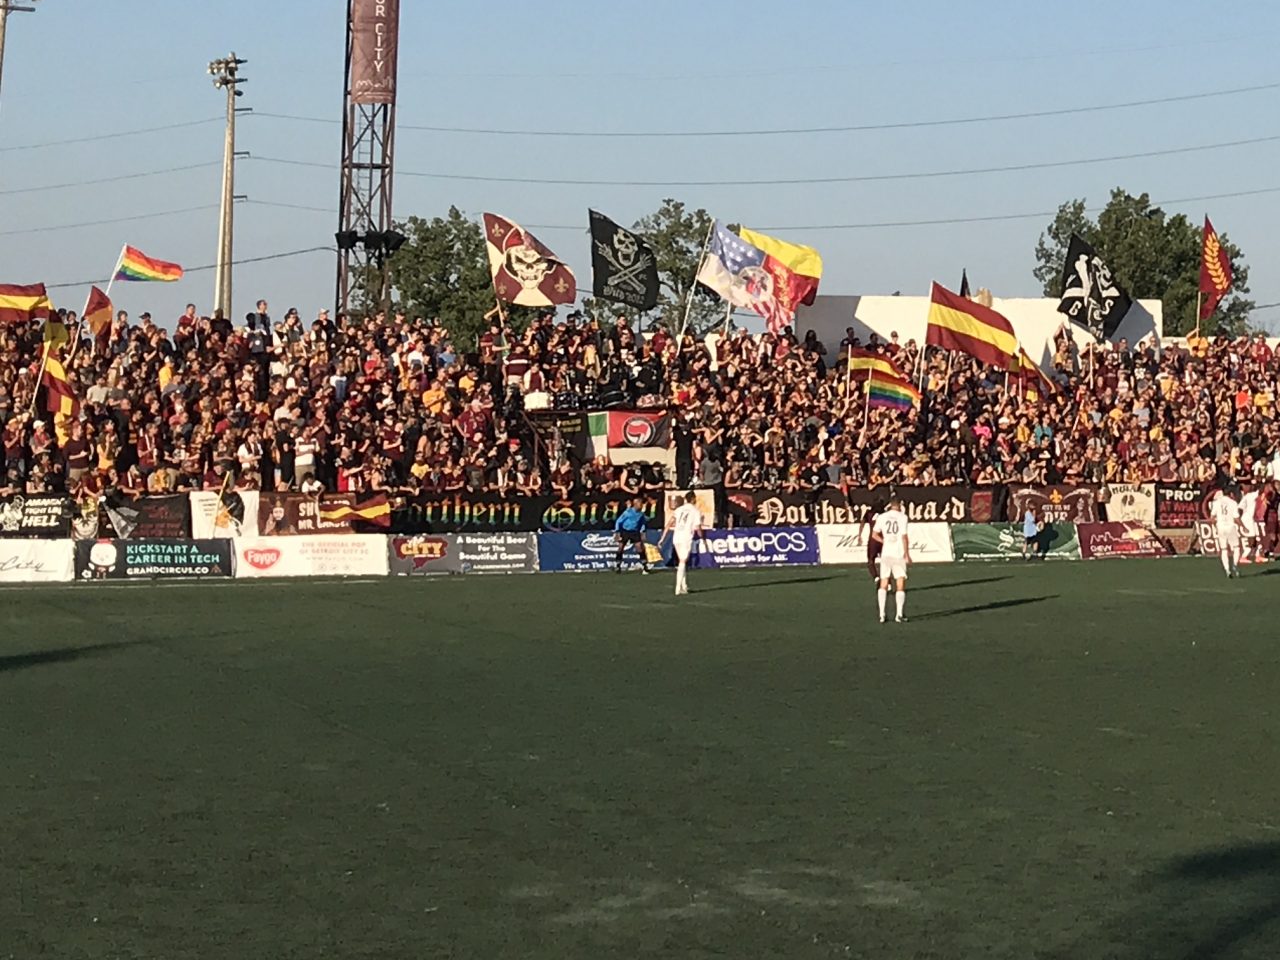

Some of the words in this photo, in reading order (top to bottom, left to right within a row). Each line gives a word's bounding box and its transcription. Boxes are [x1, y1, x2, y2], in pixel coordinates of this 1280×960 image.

[374, 23, 384, 72] CITY
[1160, 489, 1200, 502] "PRO"
[1160, 502, 1171, 512] AT
[1174, 502, 1200, 512] WHAT
[21, 515, 60, 528] HELL
[678, 511, 690, 525] 14
[885, 520, 899, 535] 20
[456, 536, 464, 544] A
[466, 536, 505, 544] Beautiful
[507, 536, 527, 544] Beer
[699, 532, 808, 554] metroPCS
[127, 545, 188, 554] KICKSTART
[190, 545, 199, 553] A
[400, 542, 443, 555] CITY
[126, 555, 171, 564] CAREER
[174, 554, 188, 563] IN
[190, 554, 220, 563] TECH
[247, 549, 278, 565] Faygo
[459, 552, 498, 561] Beautiful
[500, 552, 527, 560] Game
[714, 554, 756, 563] Wireless
[757, 554, 771, 562] for
[126, 565, 209, 575] GRANDCIRCUS.CO
[591, 561, 605, 569] The
